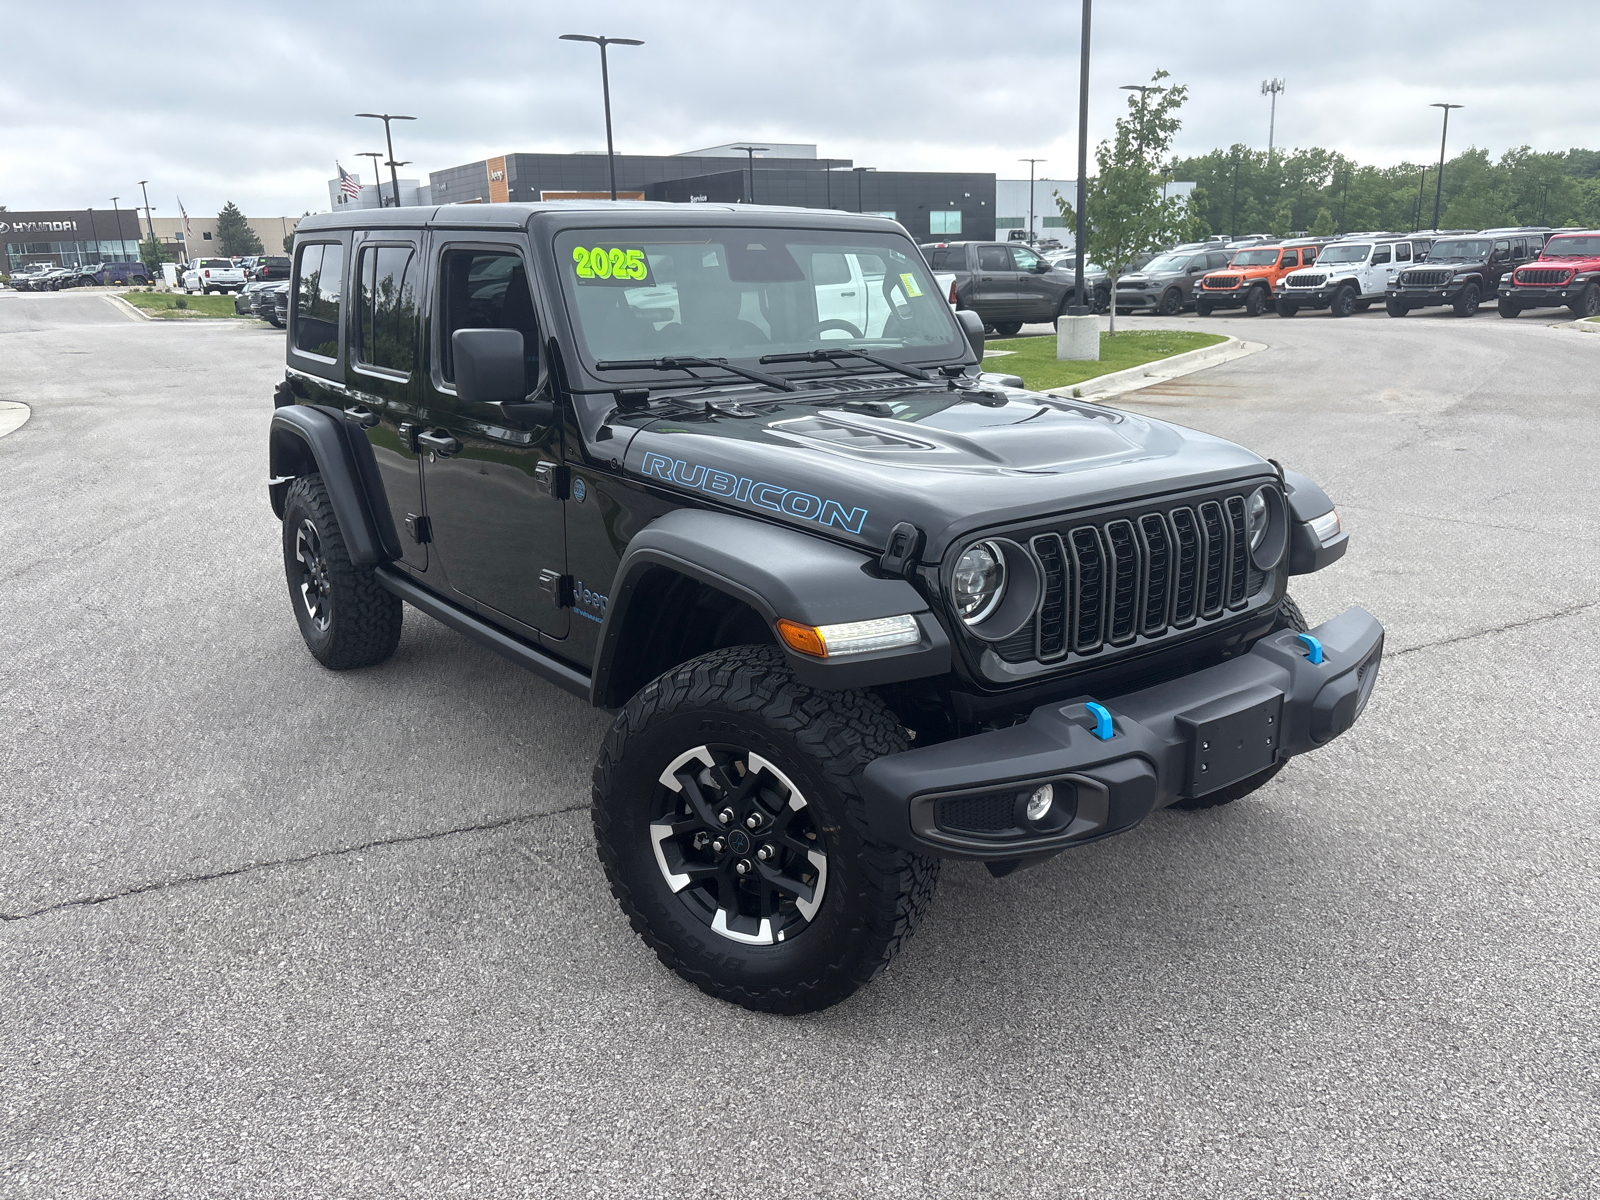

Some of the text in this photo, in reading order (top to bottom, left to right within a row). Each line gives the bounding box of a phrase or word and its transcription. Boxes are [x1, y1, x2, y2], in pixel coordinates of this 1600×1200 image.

[12, 221, 78, 233] HYUNDAI
[572, 246, 648, 281] 2025
[641, 451, 868, 534] RUBICON
